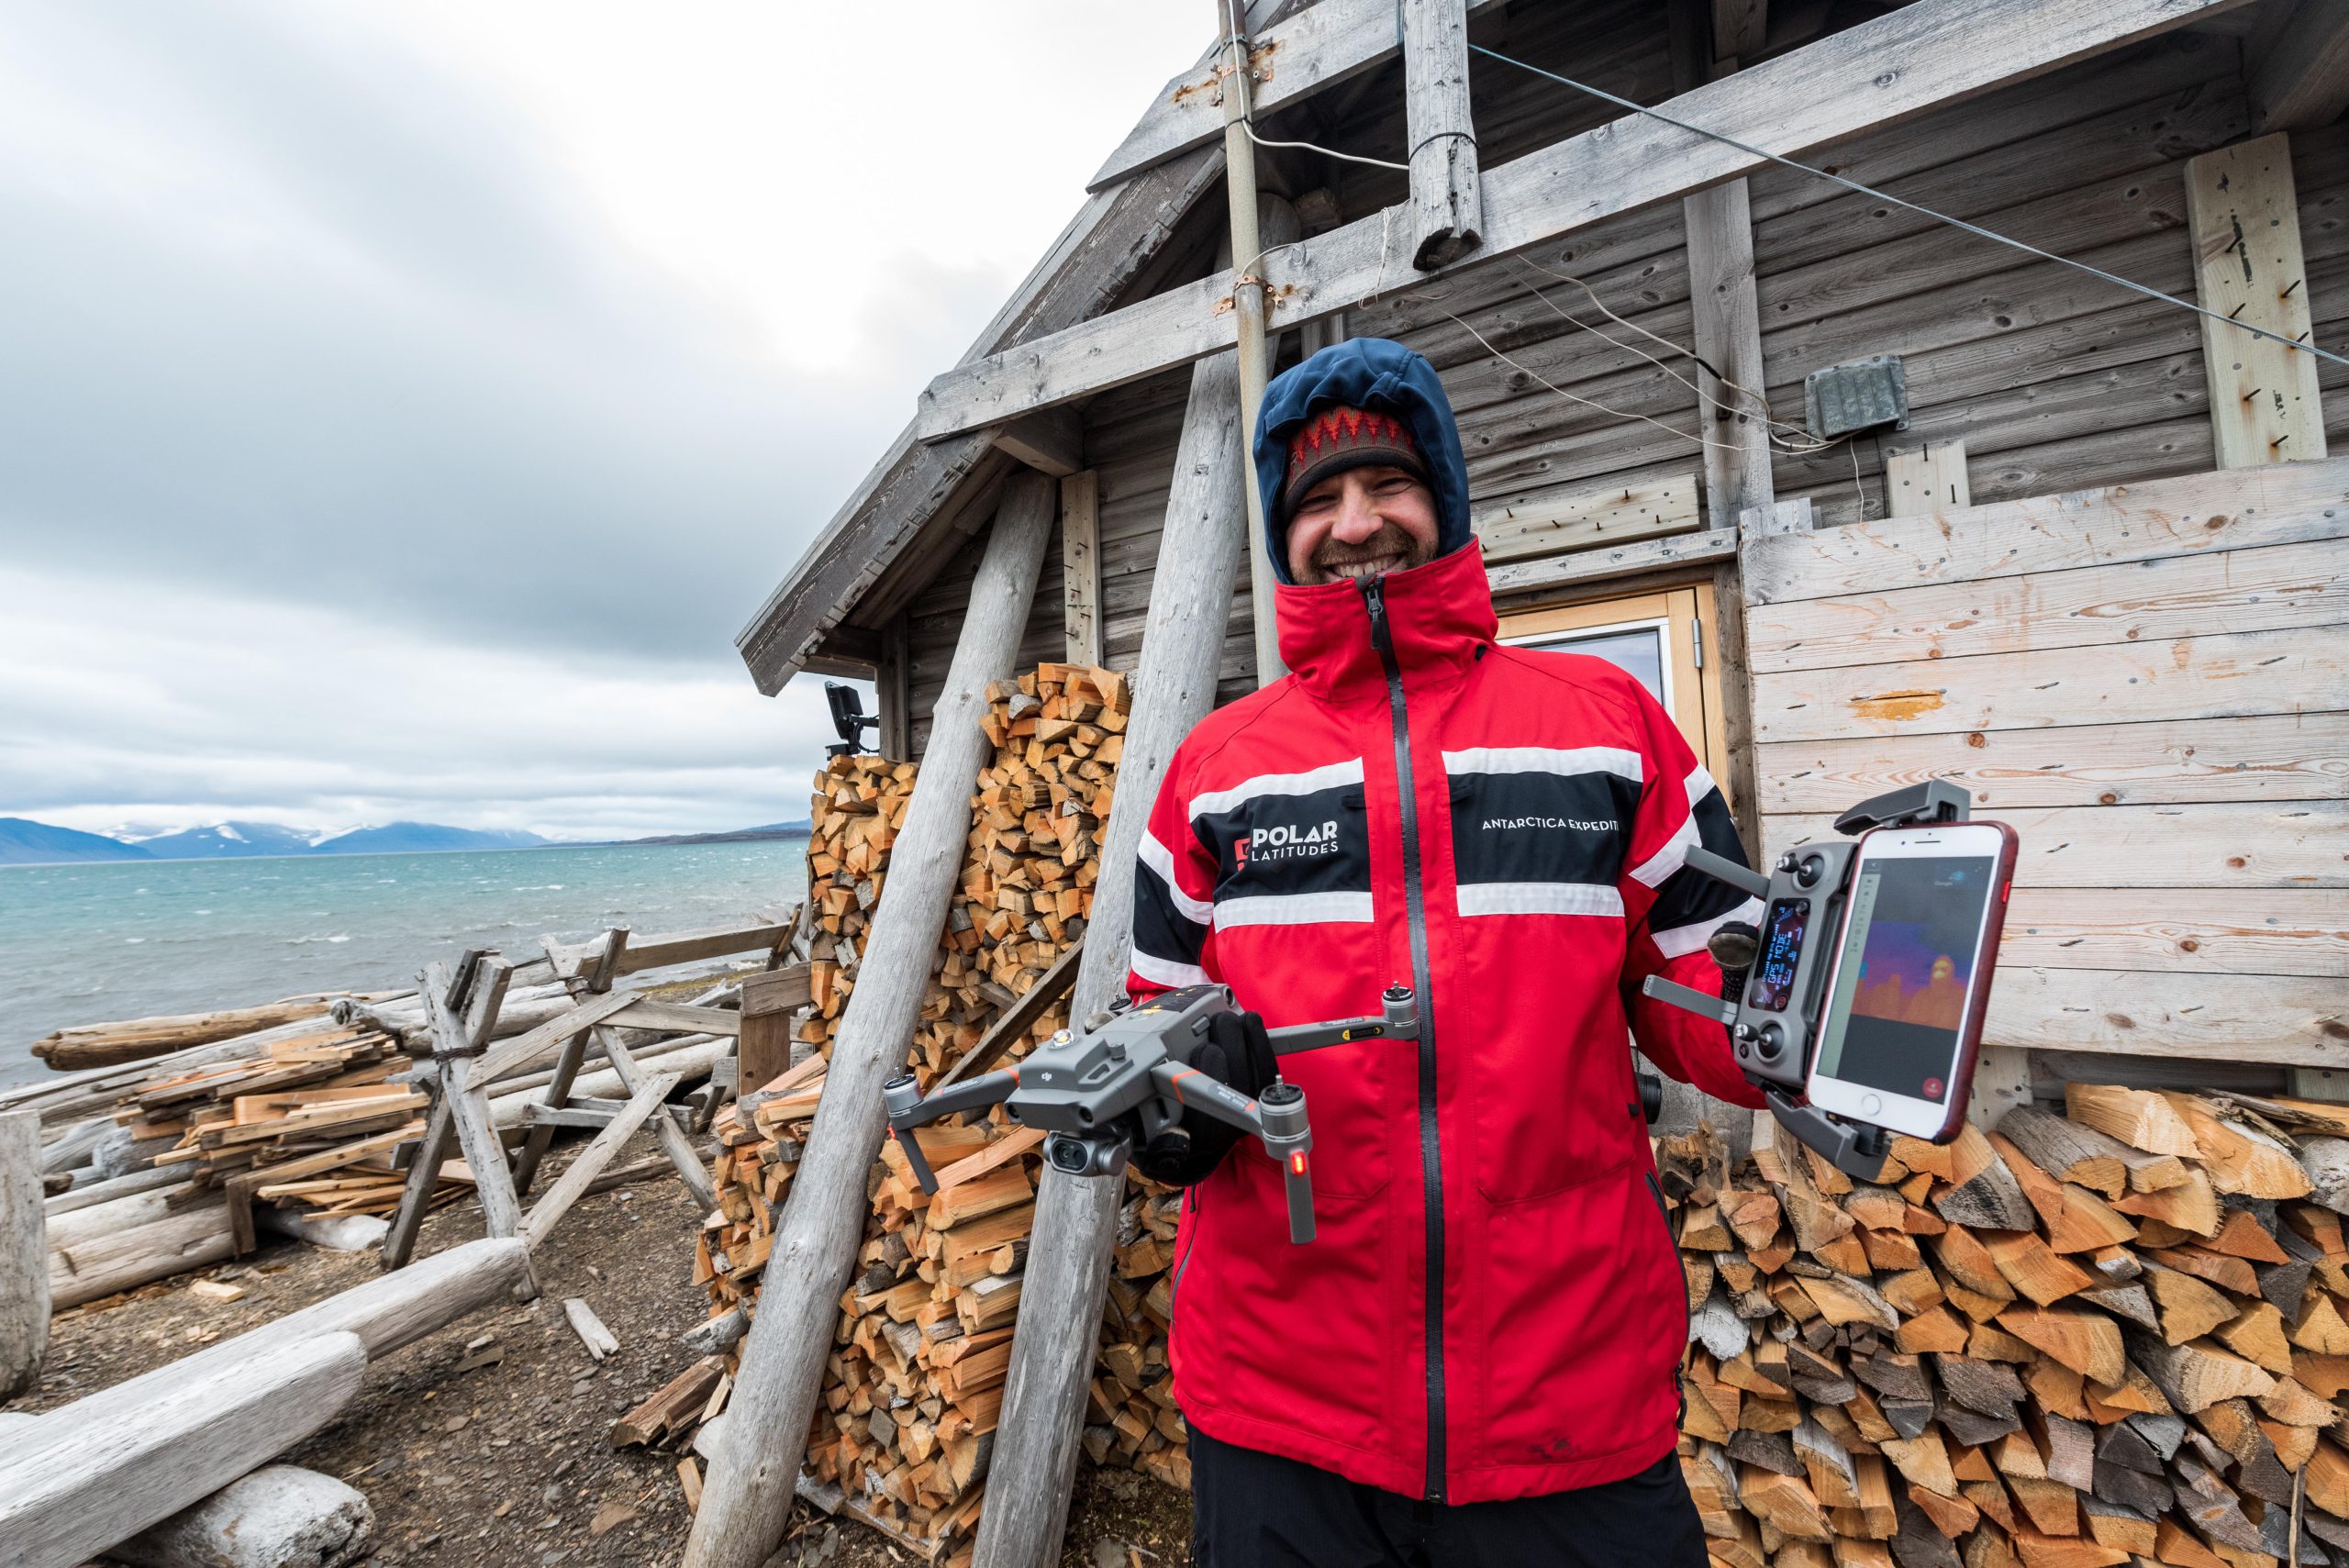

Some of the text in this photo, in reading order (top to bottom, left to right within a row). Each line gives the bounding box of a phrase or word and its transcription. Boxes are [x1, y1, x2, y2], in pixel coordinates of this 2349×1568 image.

[1252, 820, 1338, 848] POLAR
[1482, 817, 1566, 830] ANTARCTICA
[1252, 840, 1339, 862] LATITUDES
[1767, 963, 1780, 984] GPS
[1774, 933, 1787, 960] MODE
